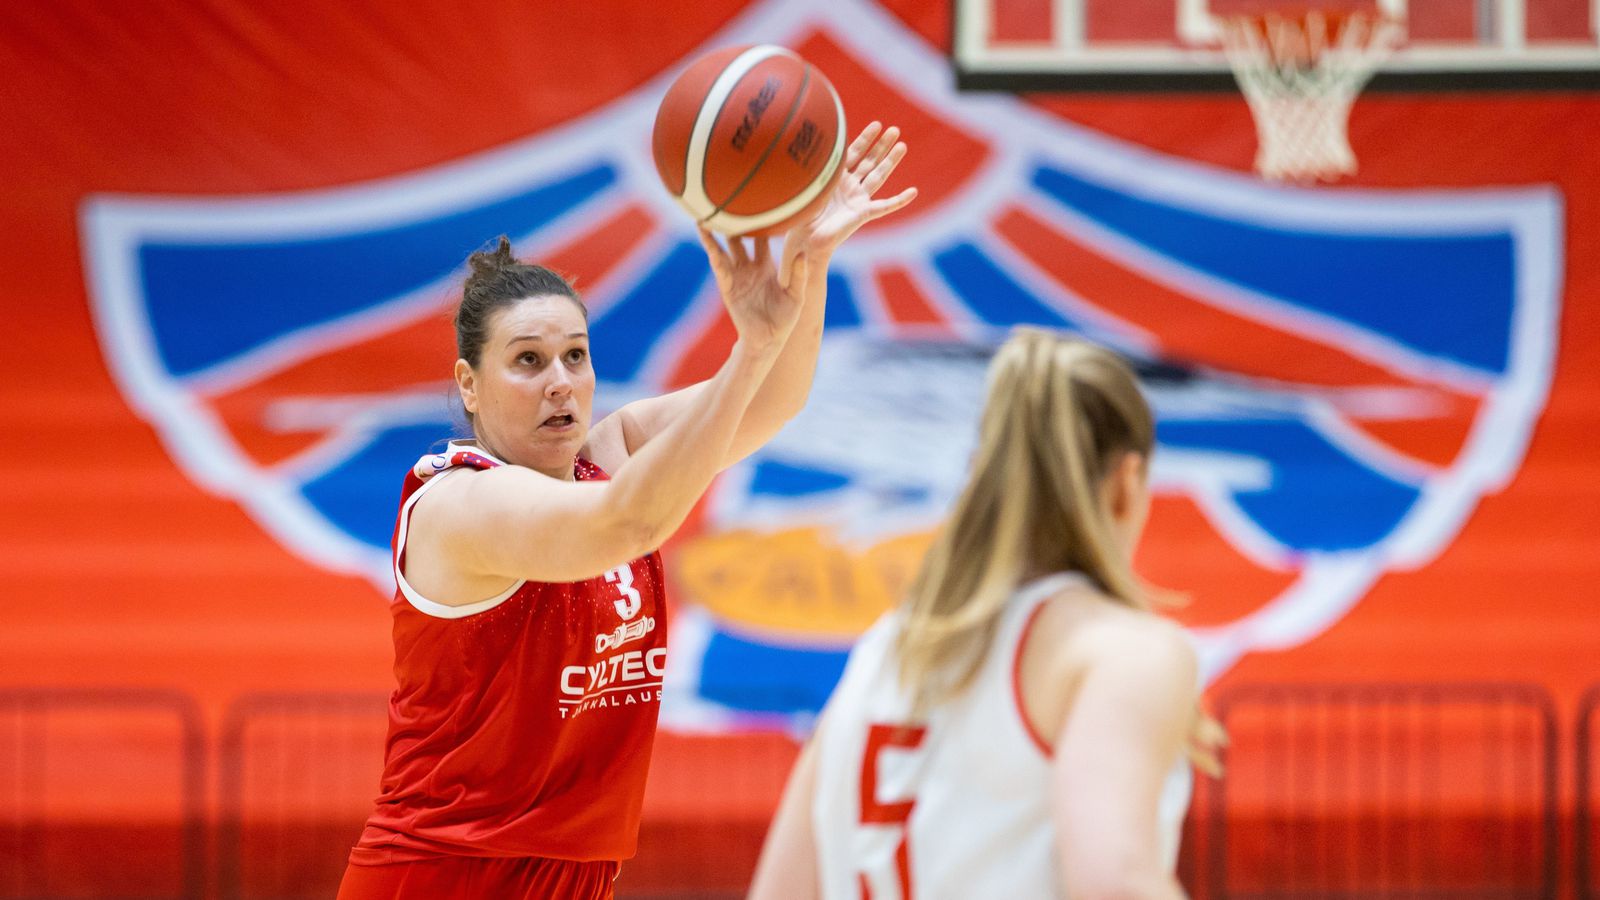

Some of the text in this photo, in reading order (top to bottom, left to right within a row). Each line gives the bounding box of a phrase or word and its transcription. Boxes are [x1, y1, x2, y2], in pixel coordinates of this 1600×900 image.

[604, 563, 642, 621] 3
[560, 647, 667, 695] CYLTEC
[857, 723, 929, 900] 5
